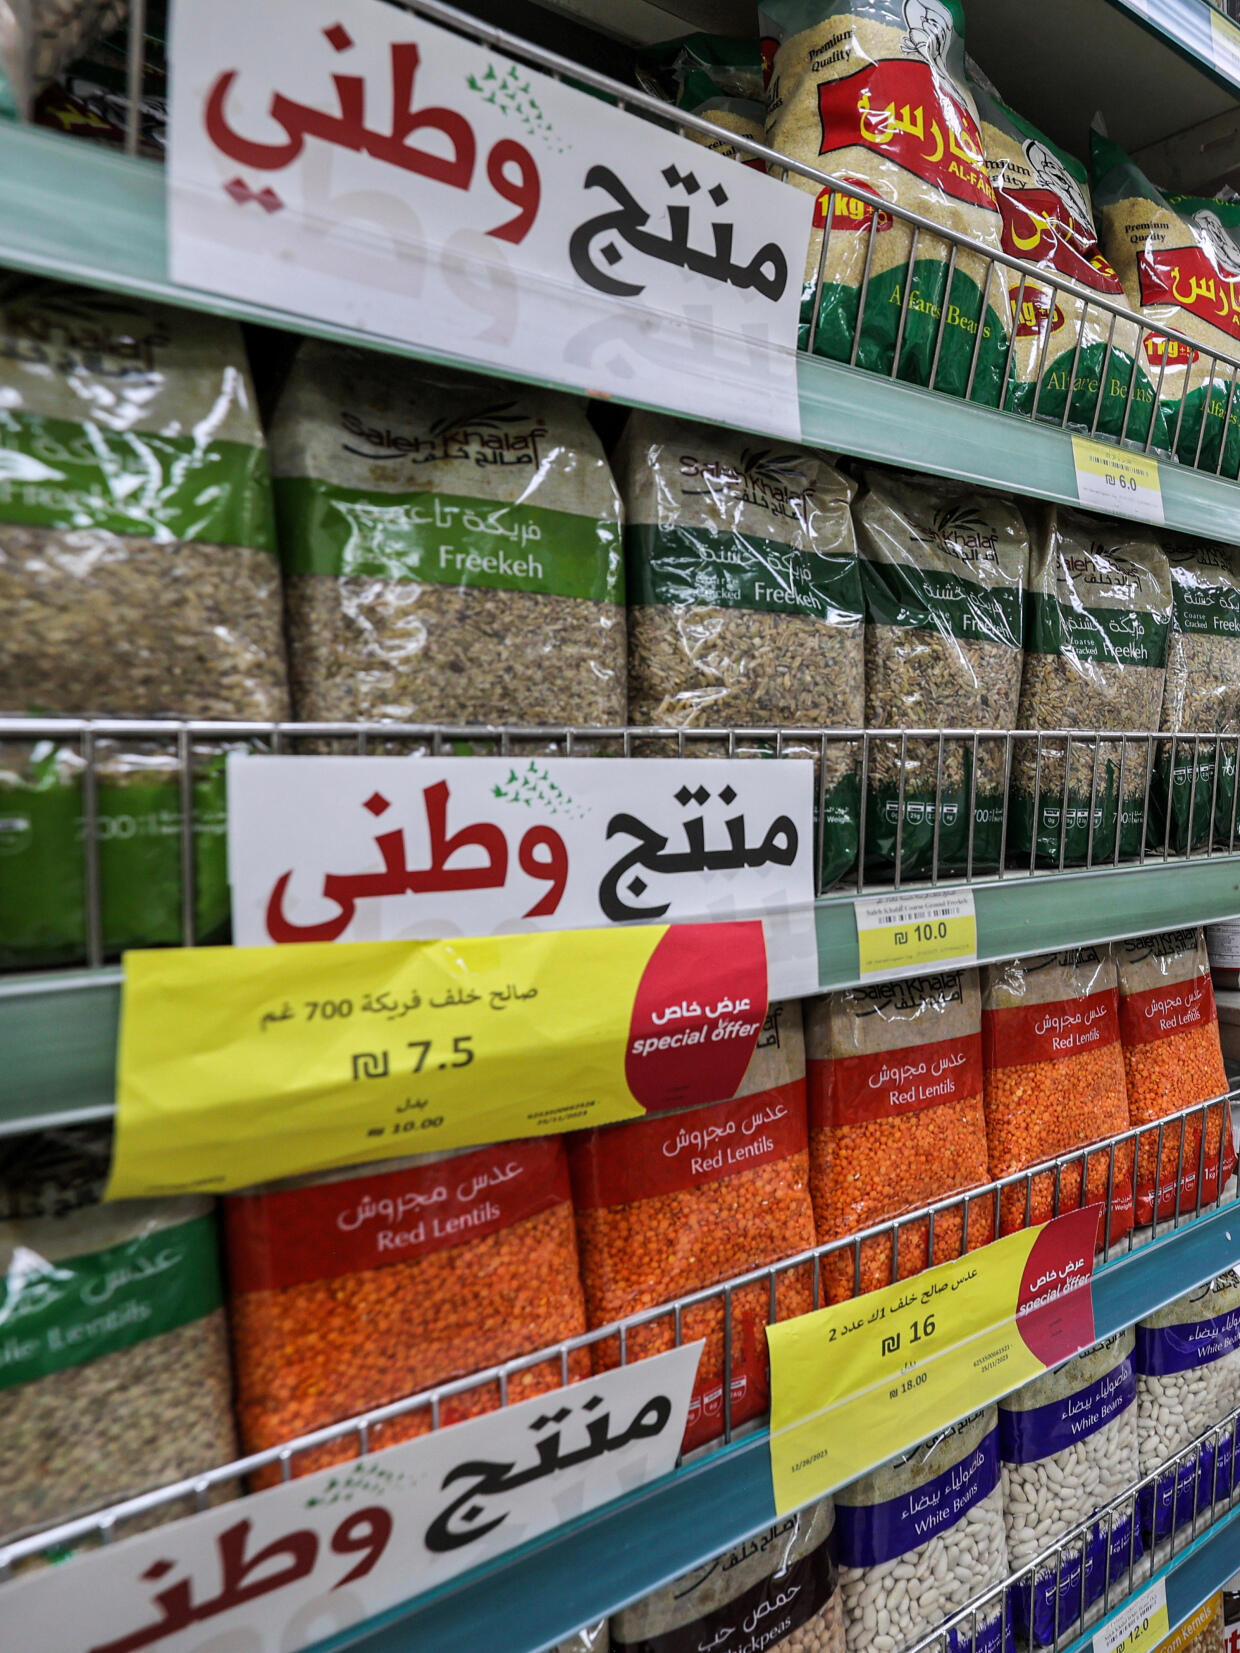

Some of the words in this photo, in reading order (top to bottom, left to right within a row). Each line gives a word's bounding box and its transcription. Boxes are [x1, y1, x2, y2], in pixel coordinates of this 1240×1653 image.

[809, 30, 852, 61] Premium
[812, 49, 851, 71] Quality
[203, 23, 542, 245] وطني
[569, 163, 789, 302] منتج
[888, 285, 941, 319] Afares
[1048, 372, 1099, 392] Alare
[1111, 379, 1152, 402] Bens
[1200, 400, 1237, 426] Alfaes
[341, 411, 433, 452] Saleh
[441, 428, 547, 469] Khalaf
[1120, 475, 1137, 491] 6.0
[440, 546, 543, 579] Freekeh
[755, 581, 821, 610] Freekeh
[1184, 619, 1208, 629] Cracked
[1103, 642, 1148, 661] Freekeh
[599, 784, 799, 922] منتج
[914, 922, 947, 942] 10.0
[304, 999, 353, 1021] 700
[361, 990, 422, 1021] فريكة
[429, 987, 482, 1010] خلف
[489, 985, 538, 1010] صالح
[705, 997, 751, 1020] عرض
[1145, 998, 1182, 1018] مجروش
[651, 1002, 702, 1026] خاص
[1034, 1012, 1082, 1036] مجروش
[1084, 1004, 1108, 1026] عدس
[1160, 1017, 1177, 1031] Red
[1179, 1008, 1201, 1026] Lentils
[632, 1025, 708, 1057] special
[711, 1019, 760, 1042] offer
[1052, 1034, 1074, 1050] Red
[1076, 1026, 1100, 1045] Lentils
[407, 1036, 475, 1073] 7.5
[931, 1051, 967, 1077] عدس
[868, 1060, 927, 1089] مجروش
[889, 1087, 916, 1106] Red
[919, 1078, 956, 1101] Lentils
[392, 1116, 445, 1136] 10.00
[742, 1104, 788, 1135] عدس
[663, 1121, 736, 1157] مجروش
[691, 1152, 723, 1175] Red
[727, 1136, 775, 1165] Lentils
[457, 1160, 524, 1202] عدس
[337, 1183, 448, 1232] مجروش
[377, 1222, 426, 1252] Red
[432, 1202, 501, 1237] Lentils
[951, 1269, 978, 1291] عدس
[1059, 1256, 1085, 1278] عرض
[920, 1281, 949, 1304] صالح
[1019, 1287, 1060, 1317] special
[1062, 1272, 1093, 1295] offer
[1029, 1270, 1057, 1292] خاص
[889, 1294, 918, 1314] خلف
[828, 1328, 837, 1342] 2
[841, 1318, 864, 1336] عدد
[909, 1314, 936, 1344] 16
[1188, 1326, 1219, 1342] بيضاء
[1197, 1342, 1222, 1358] White
[901, 1372, 928, 1394] 18.00
[1095, 1367, 1128, 1401] فاصولياء
[1061, 1395, 1093, 1420] بيضاء
[1070, 1411, 1099, 1435] White
[1101, 1395, 1123, 1418] Beans
[425, 1395, 672, 1553] منتج
[944, 1450, 985, 1497] فاصولياء
[901, 1489, 941, 1521] بيضاء
[914, 1506, 951, 1537] White
[953, 1485, 978, 1513] Beans
[85, 1506, 394, 1653] وطن
[743, 1585, 801, 1632] حمص
[1182, 1606, 1213, 1638] Kernels
[698, 1625, 737, 1652] حب
[1128, 1617, 1150, 1643] 12.0
